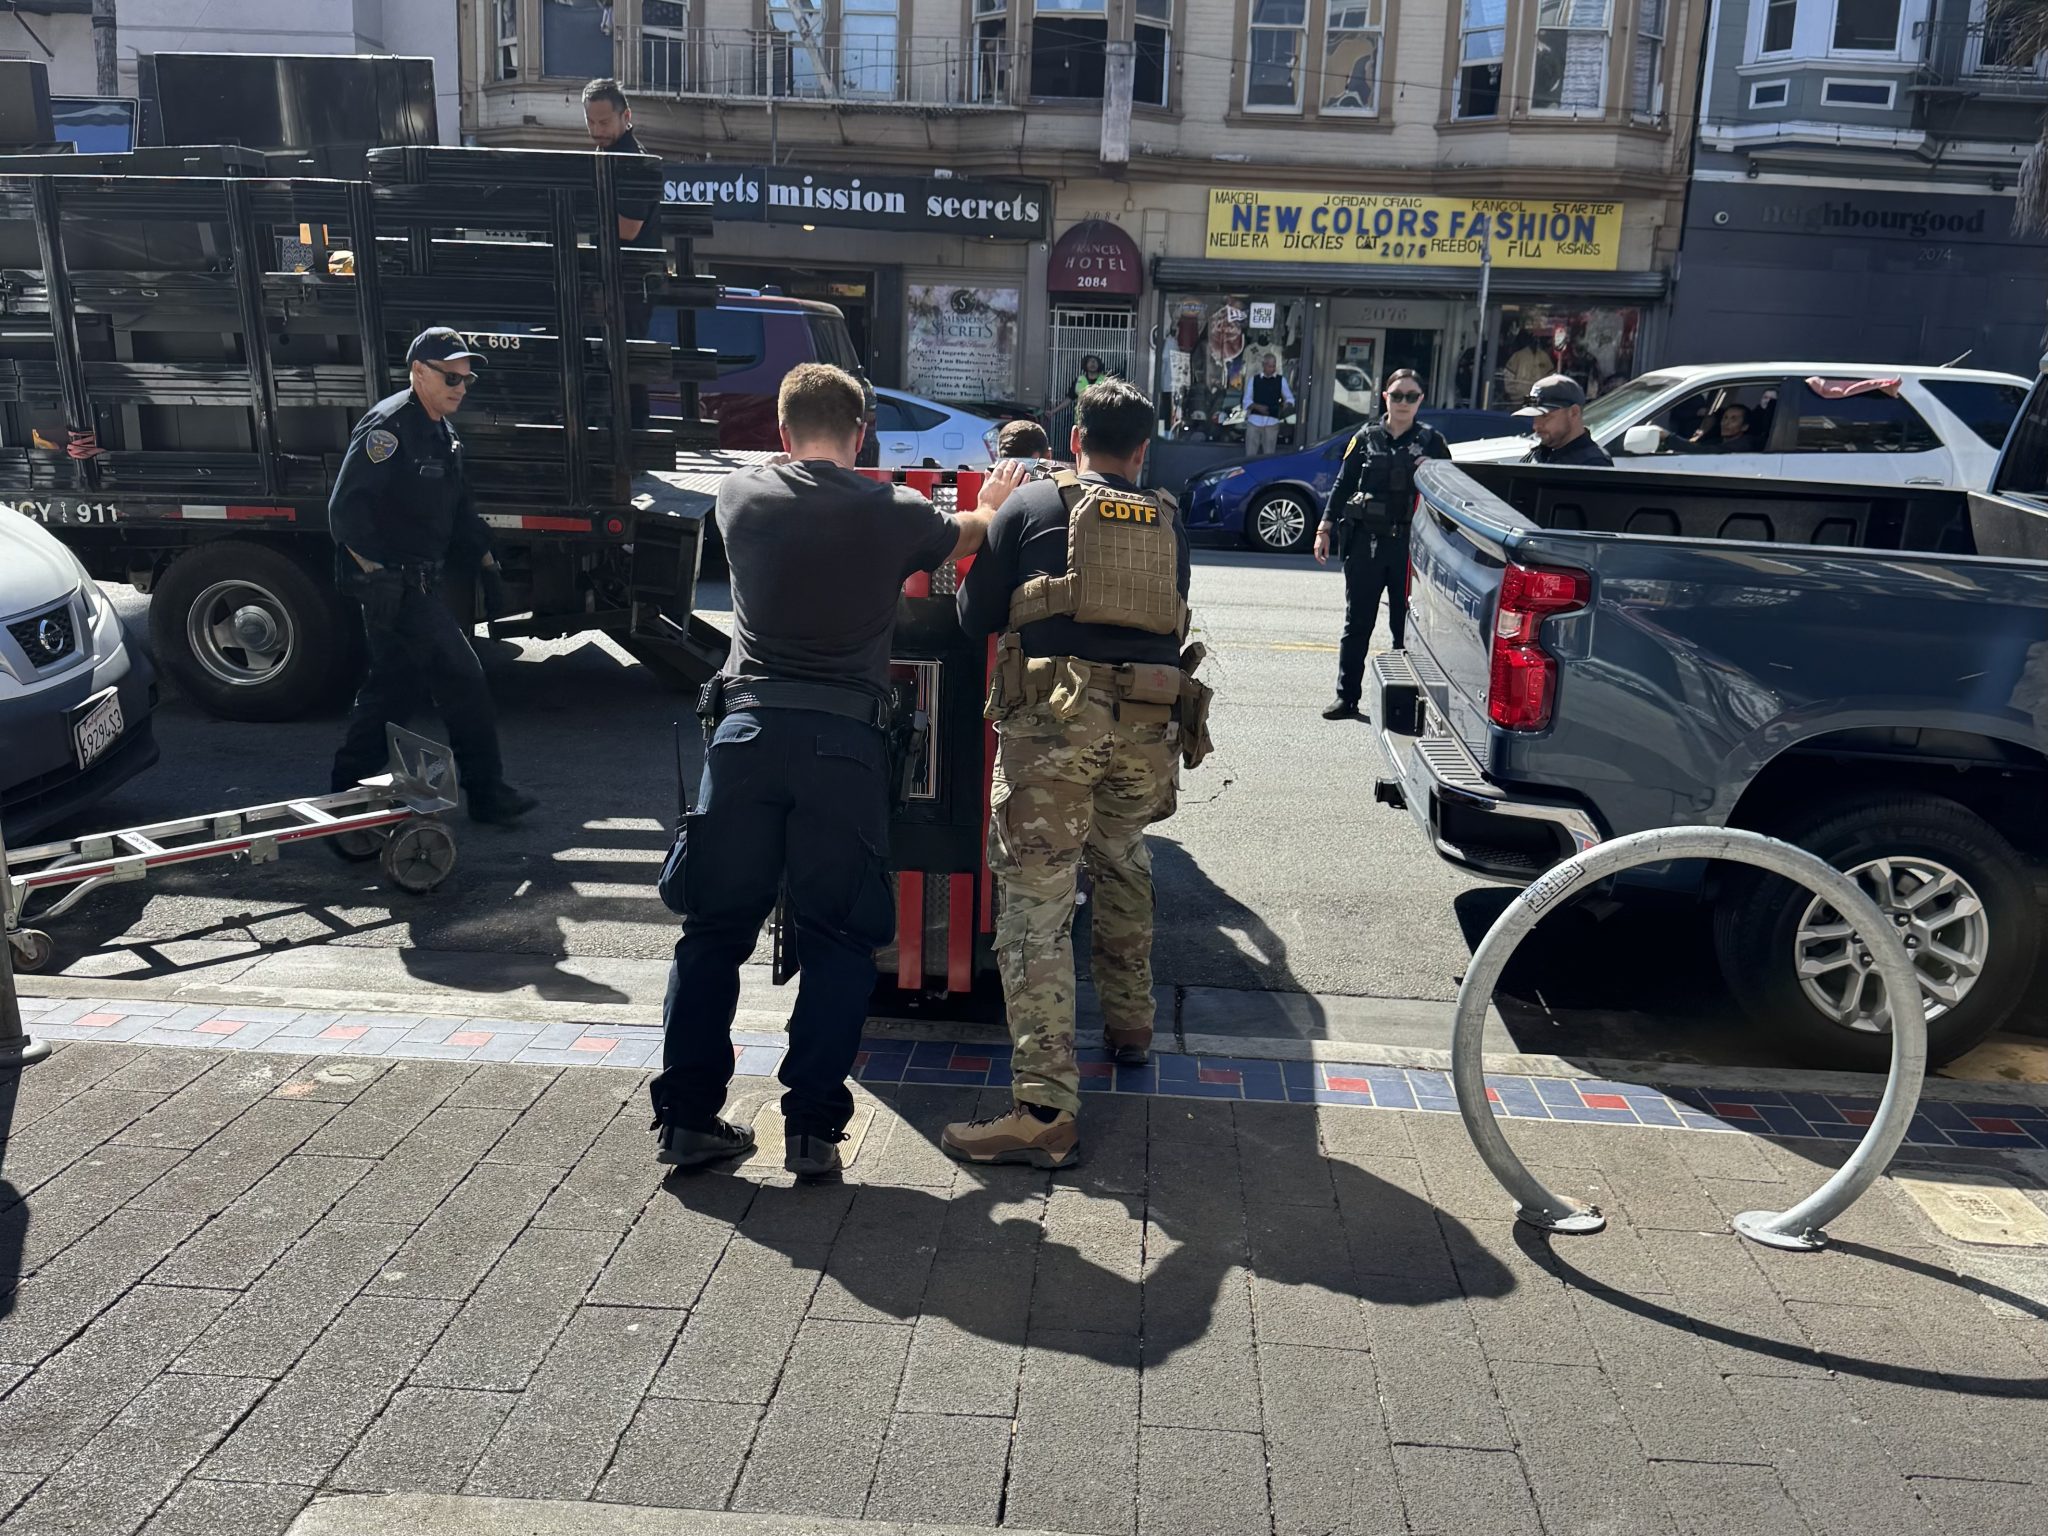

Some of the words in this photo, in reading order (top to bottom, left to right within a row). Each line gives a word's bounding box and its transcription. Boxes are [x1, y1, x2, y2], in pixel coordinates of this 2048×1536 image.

[663, 172, 759, 203] secrets
[767, 175, 907, 214] mission
[926, 193, 1040, 222] secrets
[1323, 195, 1377, 207] JORDAN
[1382, 197, 1423, 208] CRAIG
[1471, 200, 1526, 212] KANGOL
[1551, 202, 1615, 215] STARTER
[1231, 203, 1303, 234] NEW
[1311, 206, 1440, 238] COLORS
[1448, 210, 1596, 244] FASHION
[1761, 202, 1985, 237] neighbourgood
[1355, 234, 1382, 249] CAT
[1507, 240, 1542, 258] FILA
[1380, 242, 1427, 259] 2076
[1065, 256, 1127, 272] HOTEL
[1077, 276, 1108, 288] 2084
[942, 315, 983, 324] MISSION
[1252, 315, 1272, 323] ERA
[1253, 307, 1273, 316] NEW
[1362, 307, 1408, 321] 2076
[931, 320, 993, 339] SECRETS
[488, 335, 521, 350] 603
[76, 503, 118, 523] 911
[1099, 501, 1157, 524] CDTF
